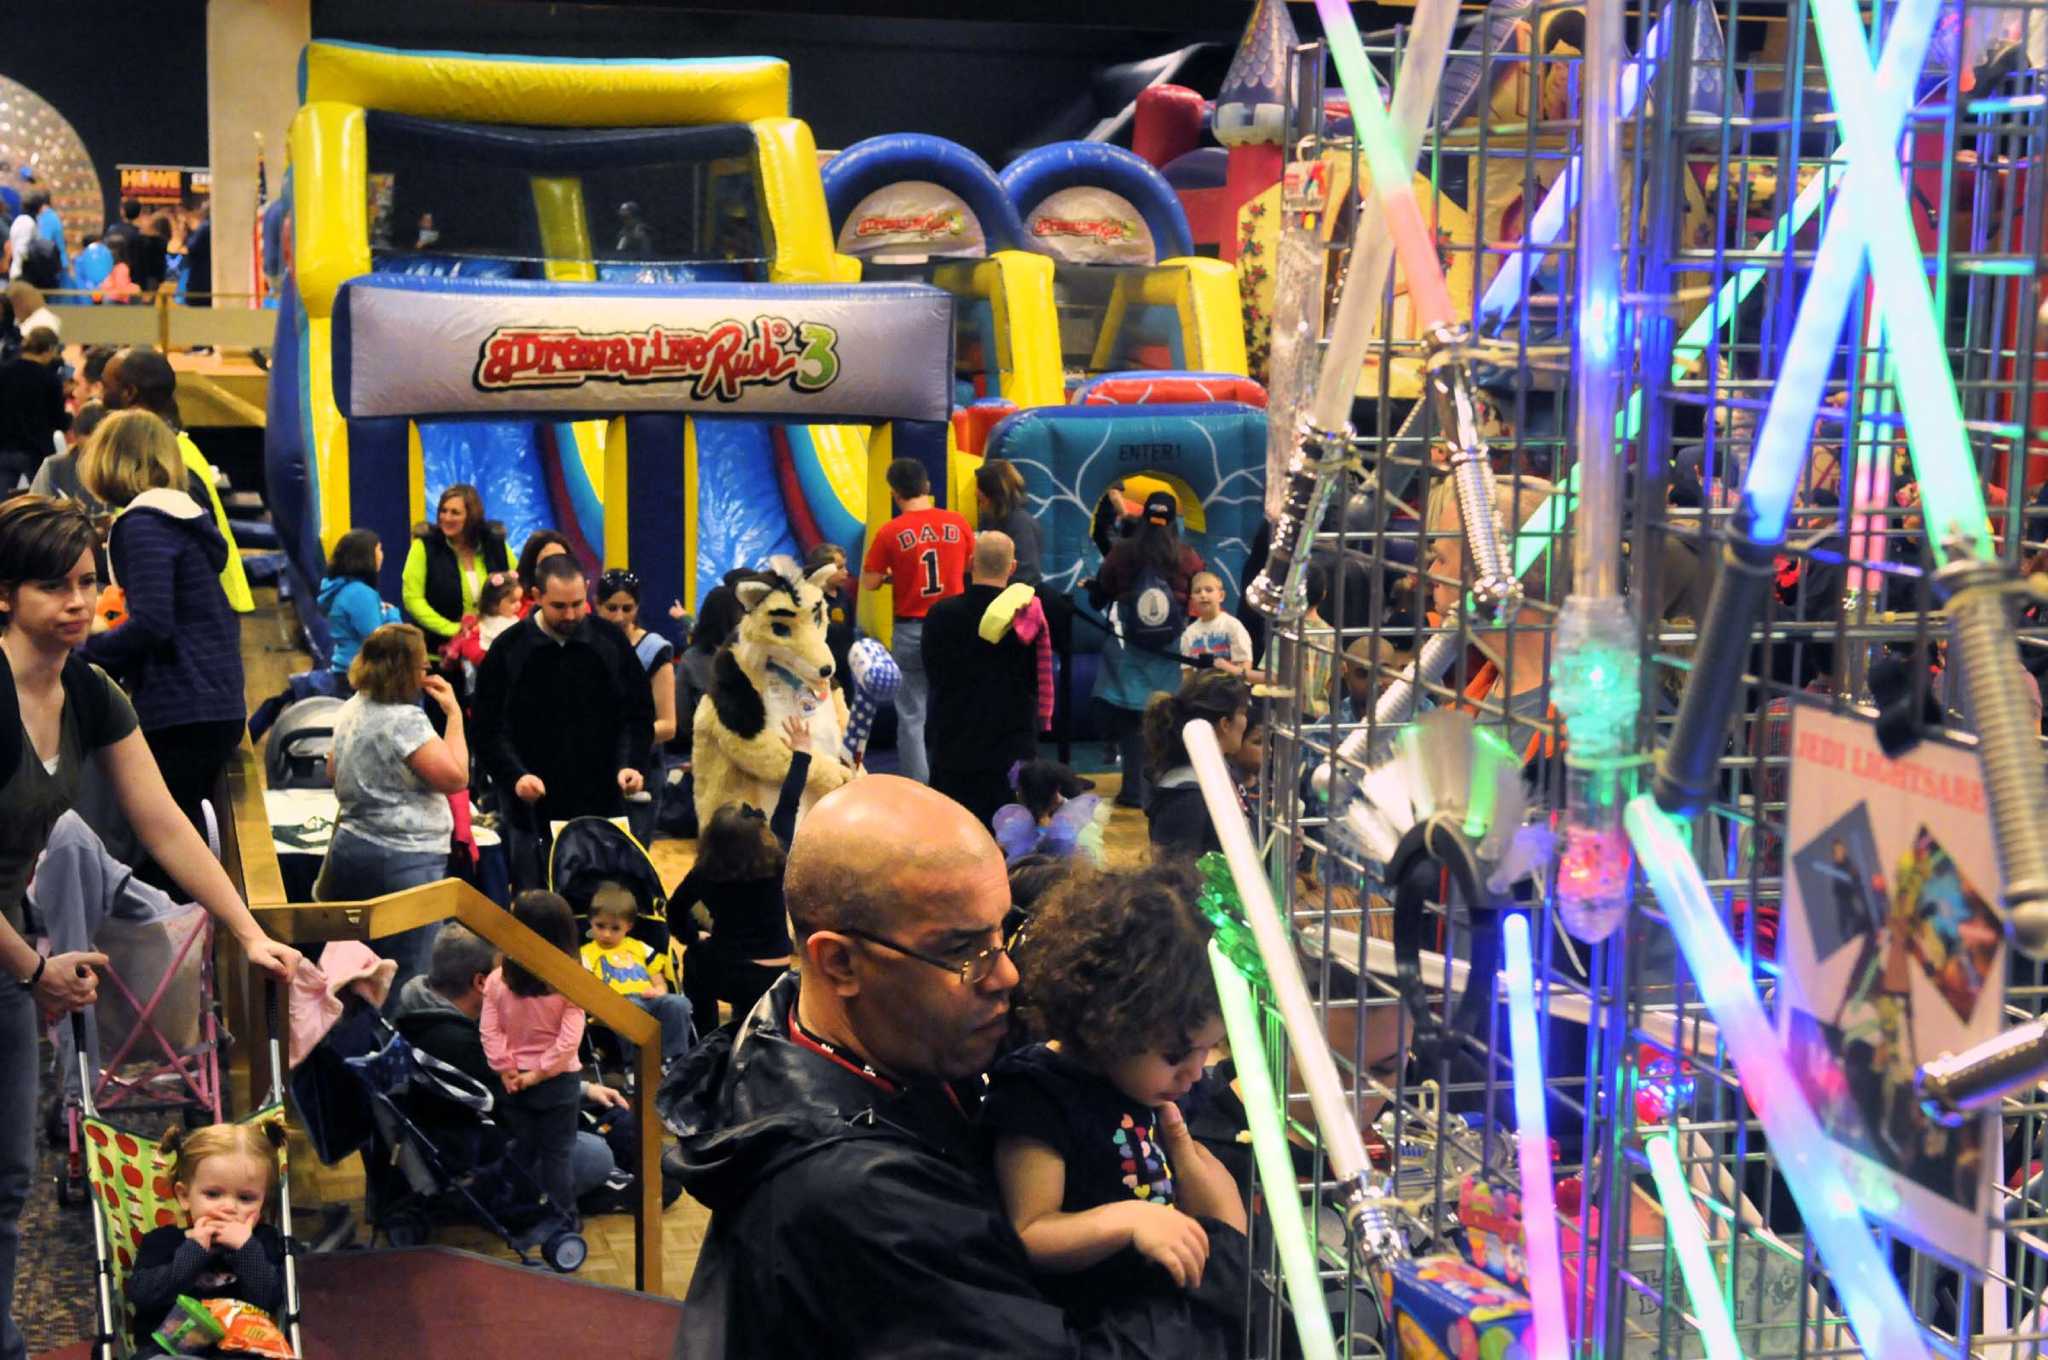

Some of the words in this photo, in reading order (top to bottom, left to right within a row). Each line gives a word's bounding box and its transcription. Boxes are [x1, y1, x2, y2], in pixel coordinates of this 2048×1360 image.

[799, 324, 837, 386] 3
[897, 524, 960, 551] DAD
[920, 548, 944, 597] 1
[1797, 731, 1847, 770] JEDI
